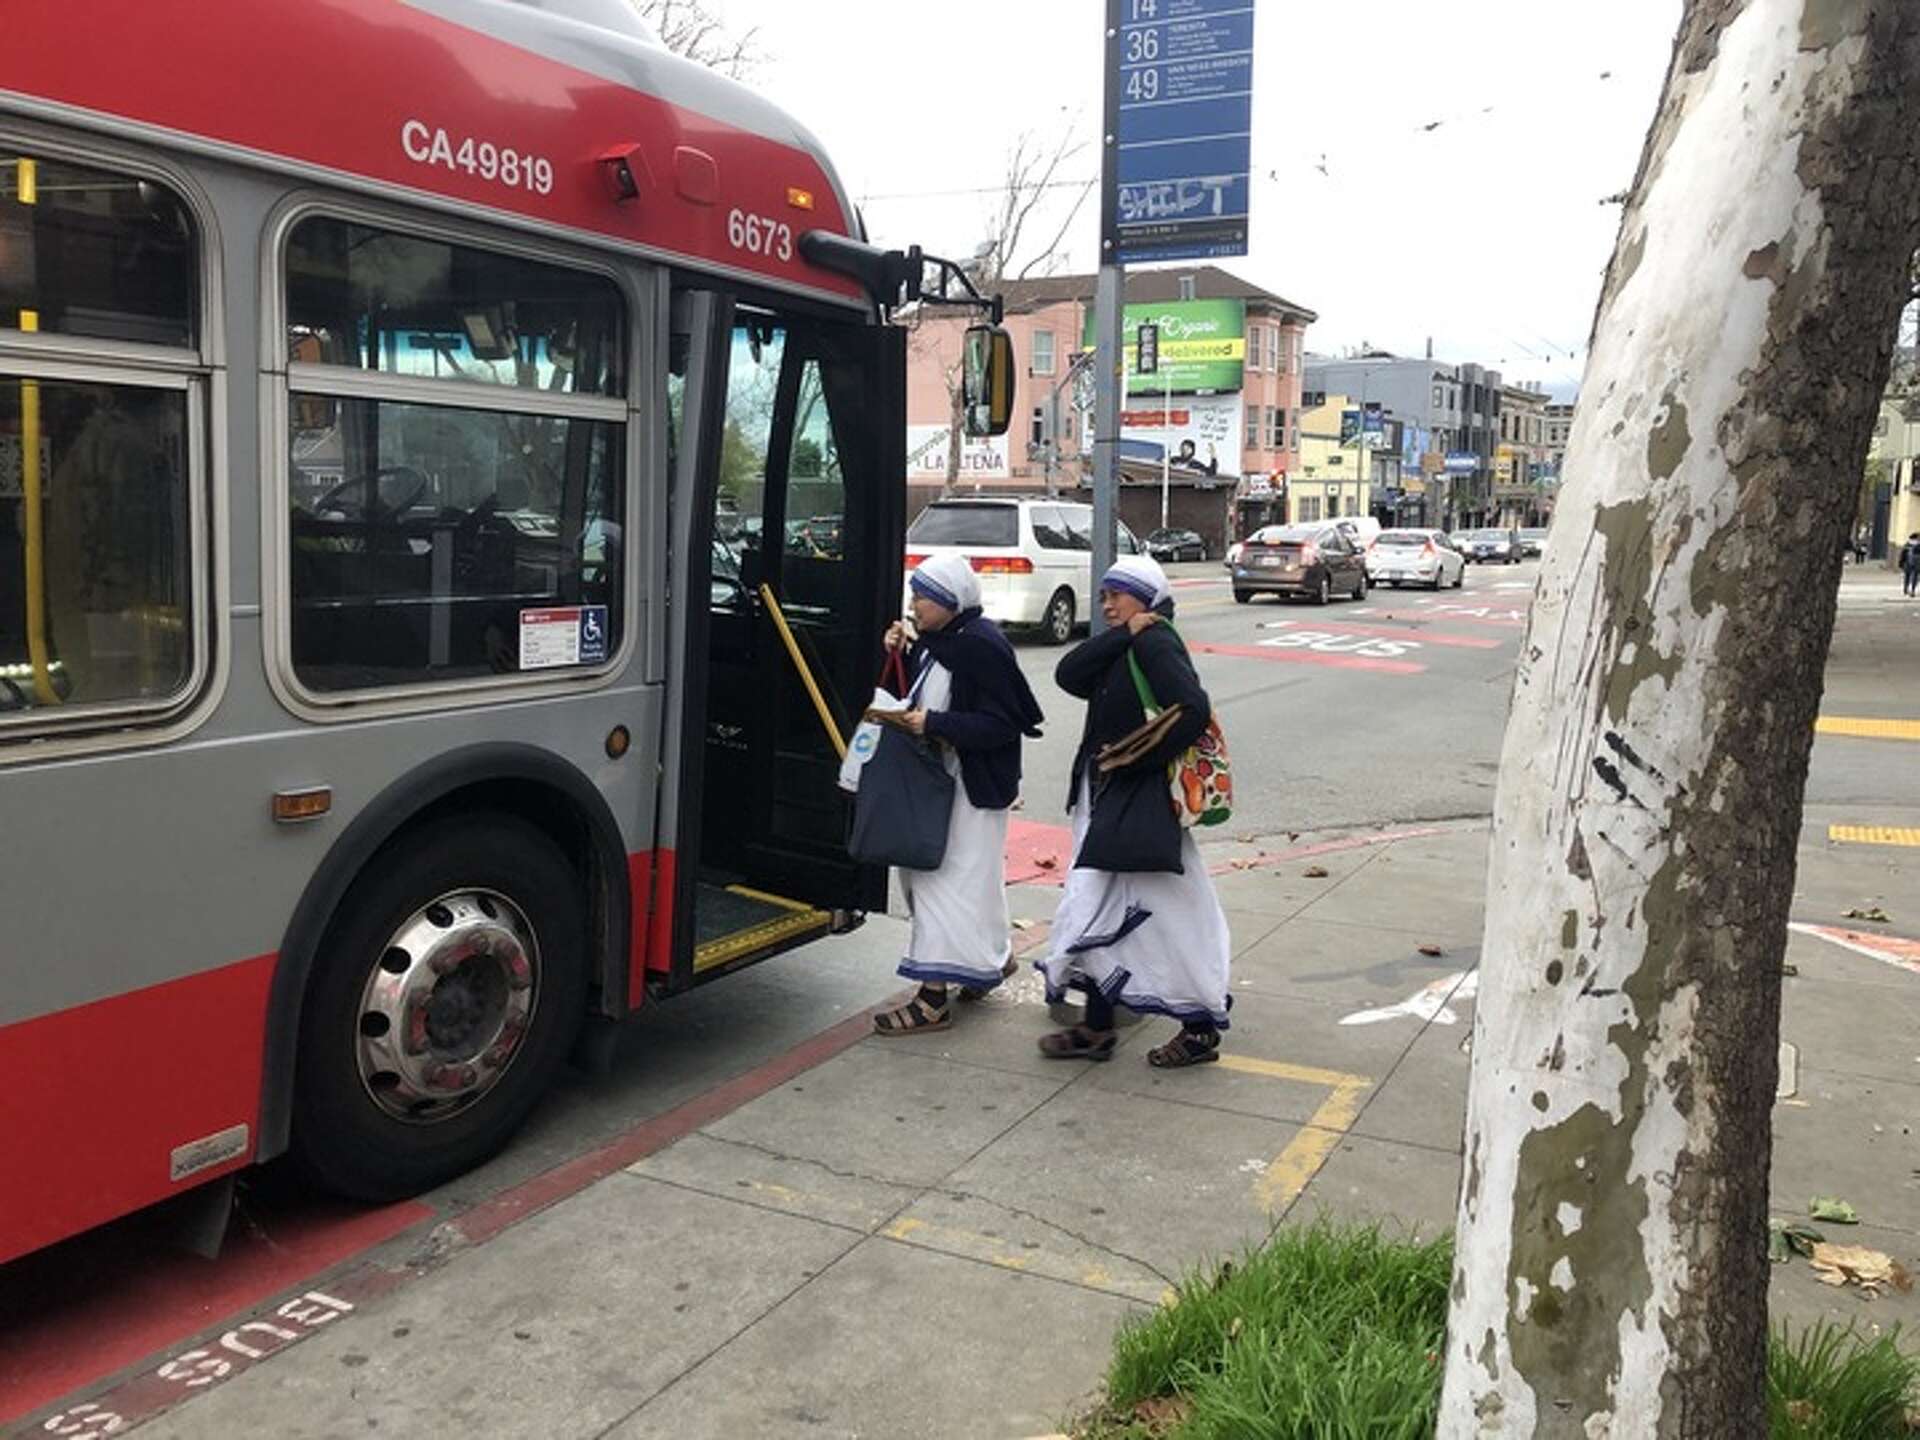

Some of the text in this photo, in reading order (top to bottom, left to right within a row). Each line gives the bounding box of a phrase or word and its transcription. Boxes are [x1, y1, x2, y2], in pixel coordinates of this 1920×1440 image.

[1130, 0, 1157, 20] 14
[1126, 29, 1158, 62] 36
[1126, 68, 1158, 100] 49
[402, 119, 553, 195] CA49819
[728, 208, 792, 261] 6673
[1257, 631, 1421, 656] BUS
[158, 1291, 355, 1387] BUS
